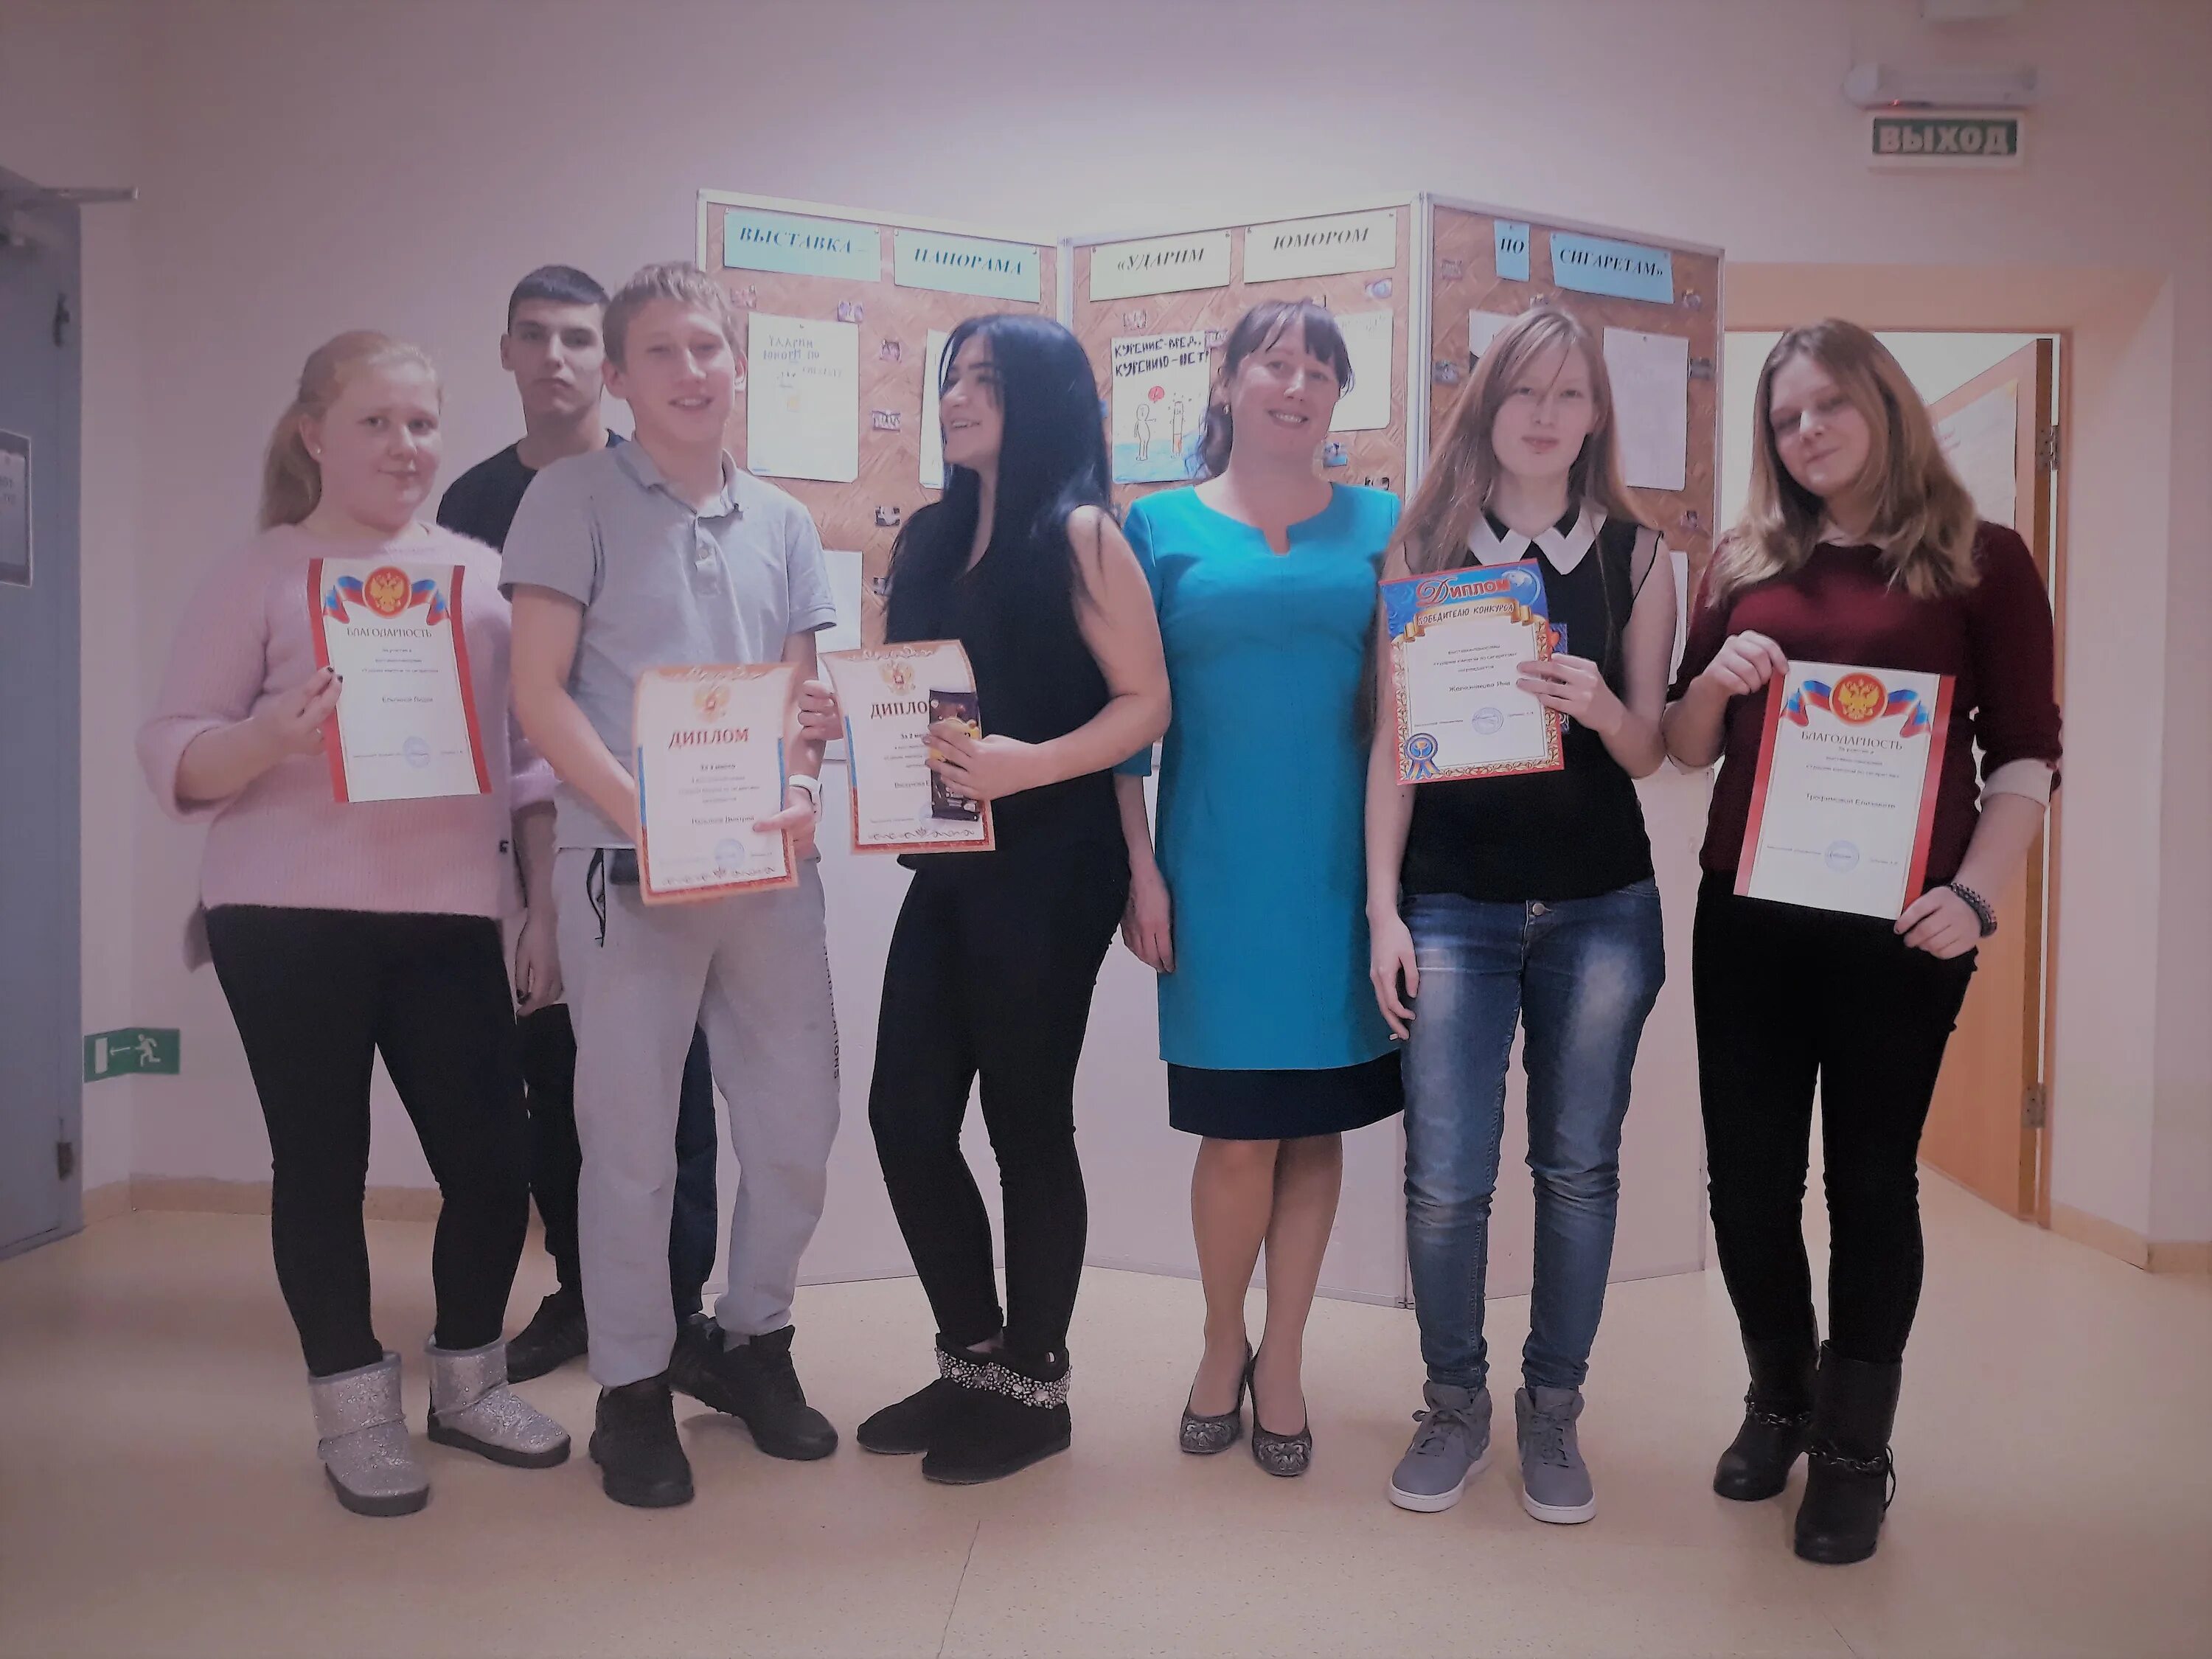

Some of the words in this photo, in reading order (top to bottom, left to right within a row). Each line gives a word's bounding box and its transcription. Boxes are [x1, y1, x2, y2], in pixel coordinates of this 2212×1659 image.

[1878, 125, 2009, 155] ВЫХОД
[740, 226, 852, 254] ВЫСТАВКА
[1273, 226, 1369, 251] ЮМОРОМ
[1499, 237, 1525, 254] ПО
[914, 247, 1023, 276] ПАНОРАМА
[1117, 247, 1205, 272] «УДАРИМ
[1559, 248, 1664, 277] СИГАРЕТАМ»
[1417, 608, 1470, 626] ПОБЕДИТЕЛЮ
[1472, 602, 1514, 615] КОНКУРСА
[346, 625, 433, 639] БЛАГОДАРНОСТЬ
[870, 701, 928, 720] ДИПЛО
[668, 727, 750, 750] ДИПЛОМ
[1801, 730, 1903, 751] БЛАГОДАРНОСТЬ
